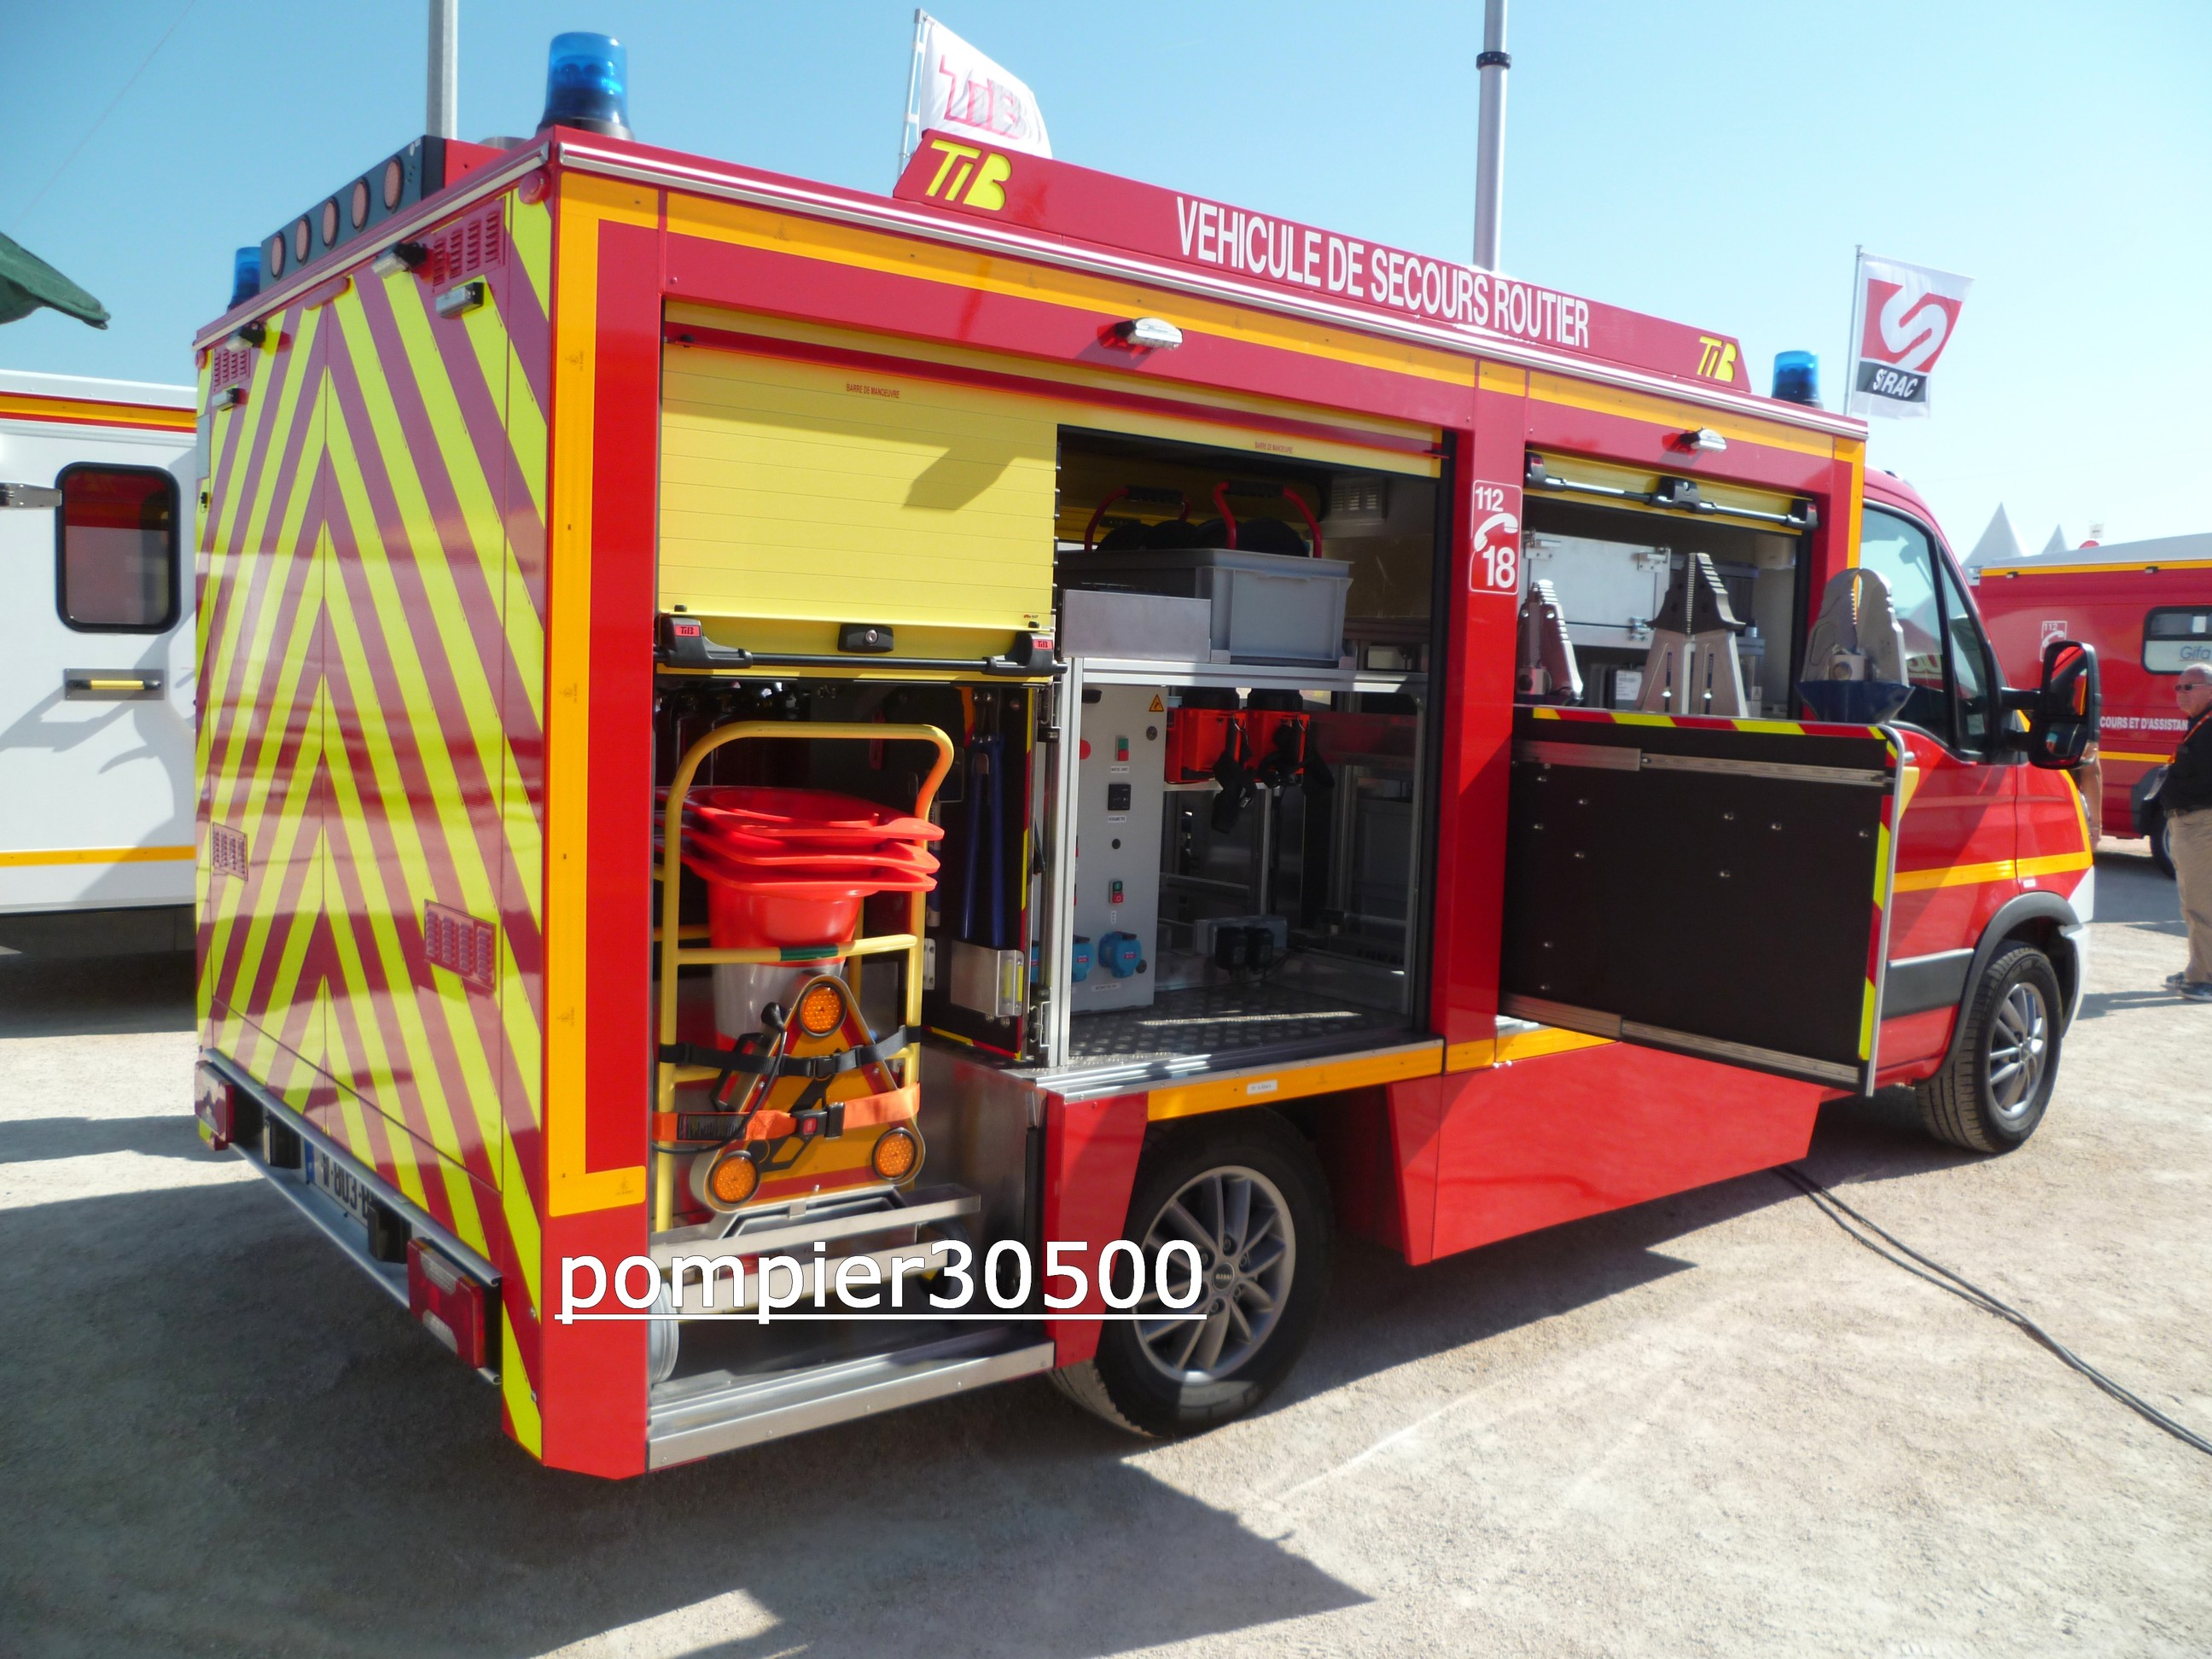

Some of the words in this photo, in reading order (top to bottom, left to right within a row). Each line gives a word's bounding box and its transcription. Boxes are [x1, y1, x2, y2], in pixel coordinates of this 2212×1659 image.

[1177, 196, 1321, 287] VEHICULE
[1329, 236, 1364, 297] DE
[1371, 248, 1488, 326] SECOURS
[1494, 279, 1589, 348] ROUTIER
[847, 383, 863, 393] BARRE
[864, 386, 870, 394] DE
[870, 387, 900, 399] MANOEUVRE
[1476, 486, 1504, 512] 112
[1482, 545, 1516, 588] 18
[2099, 716, 2128, 729] COURS
[2128, 717, 2139, 729] ET
